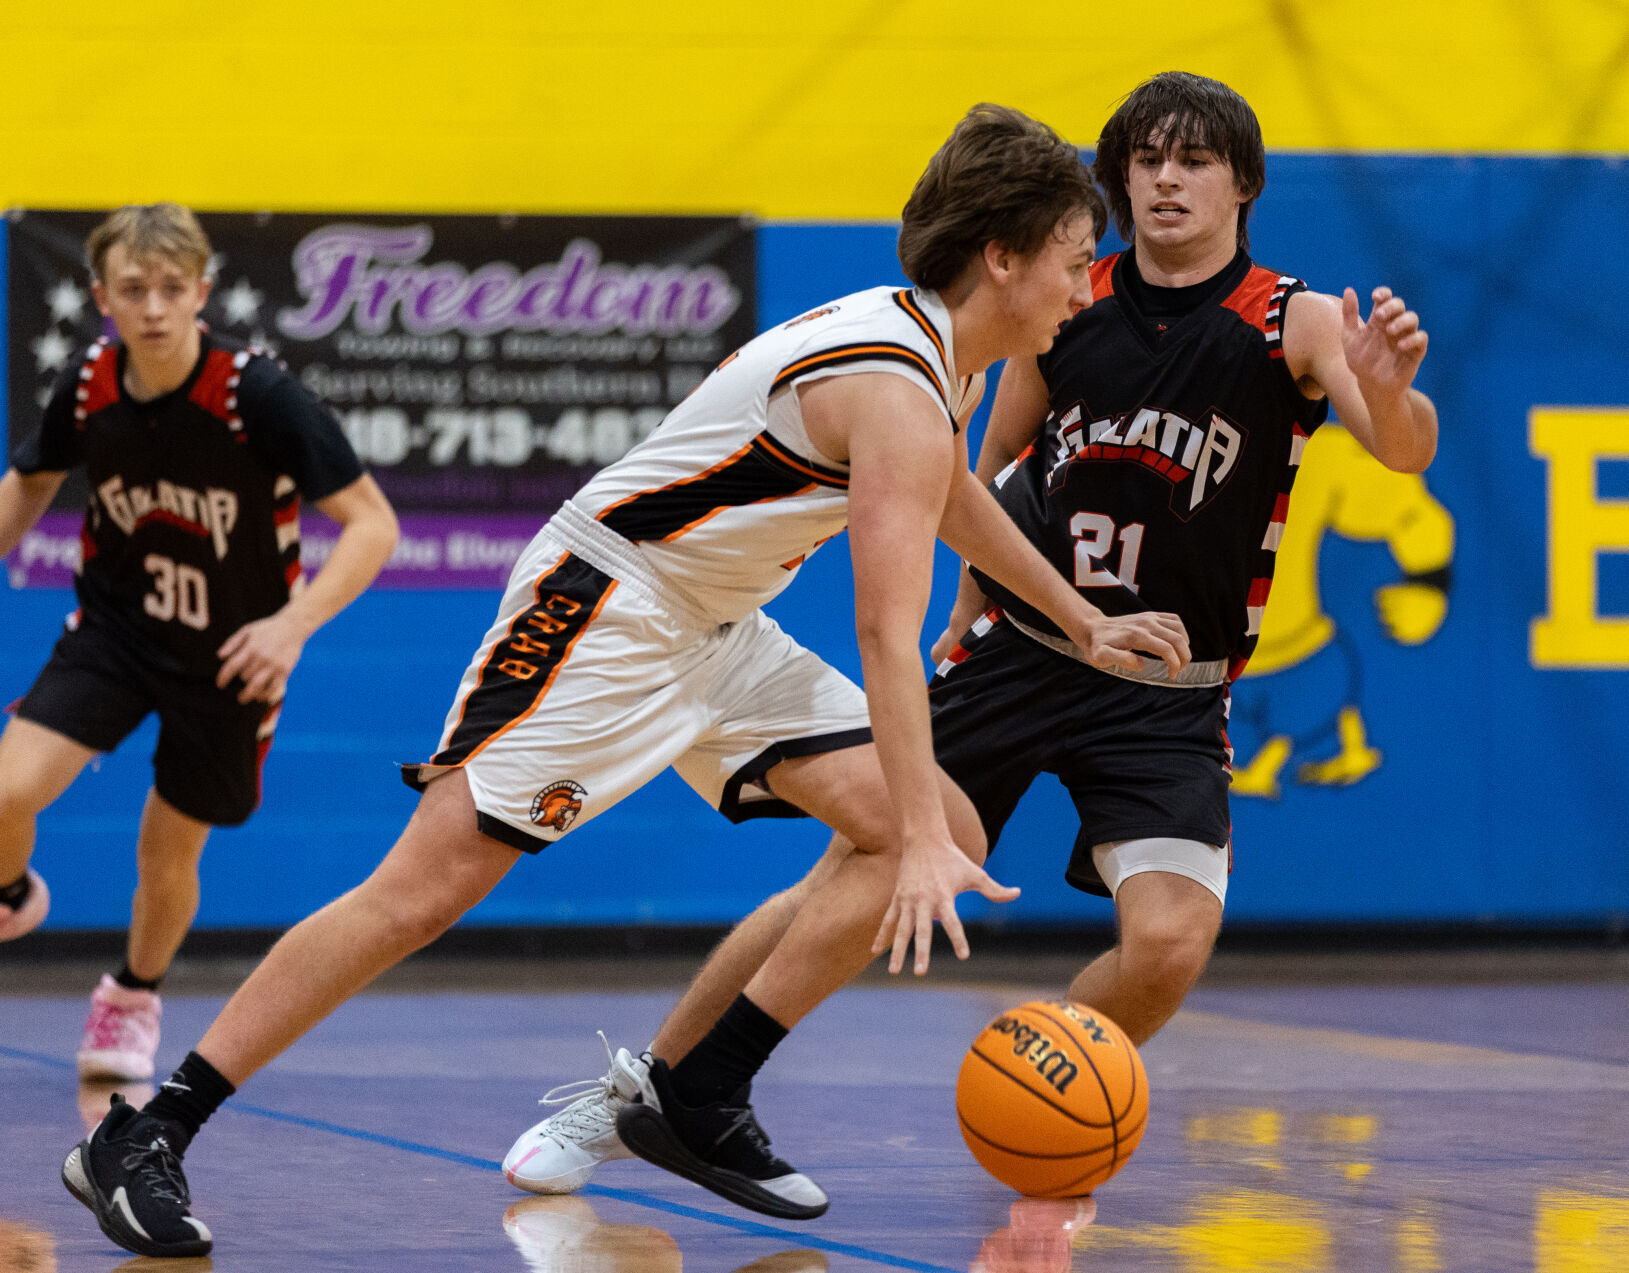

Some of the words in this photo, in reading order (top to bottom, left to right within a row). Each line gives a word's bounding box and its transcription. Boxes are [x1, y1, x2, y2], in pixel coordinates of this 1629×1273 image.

[277, 224, 742, 342] Freedom
[1053, 404, 1242, 511] GALATIA
[143, 553, 210, 631] 30
[1069, 511, 1145, 596] 21
[498, 594, 581, 680] CRAB
